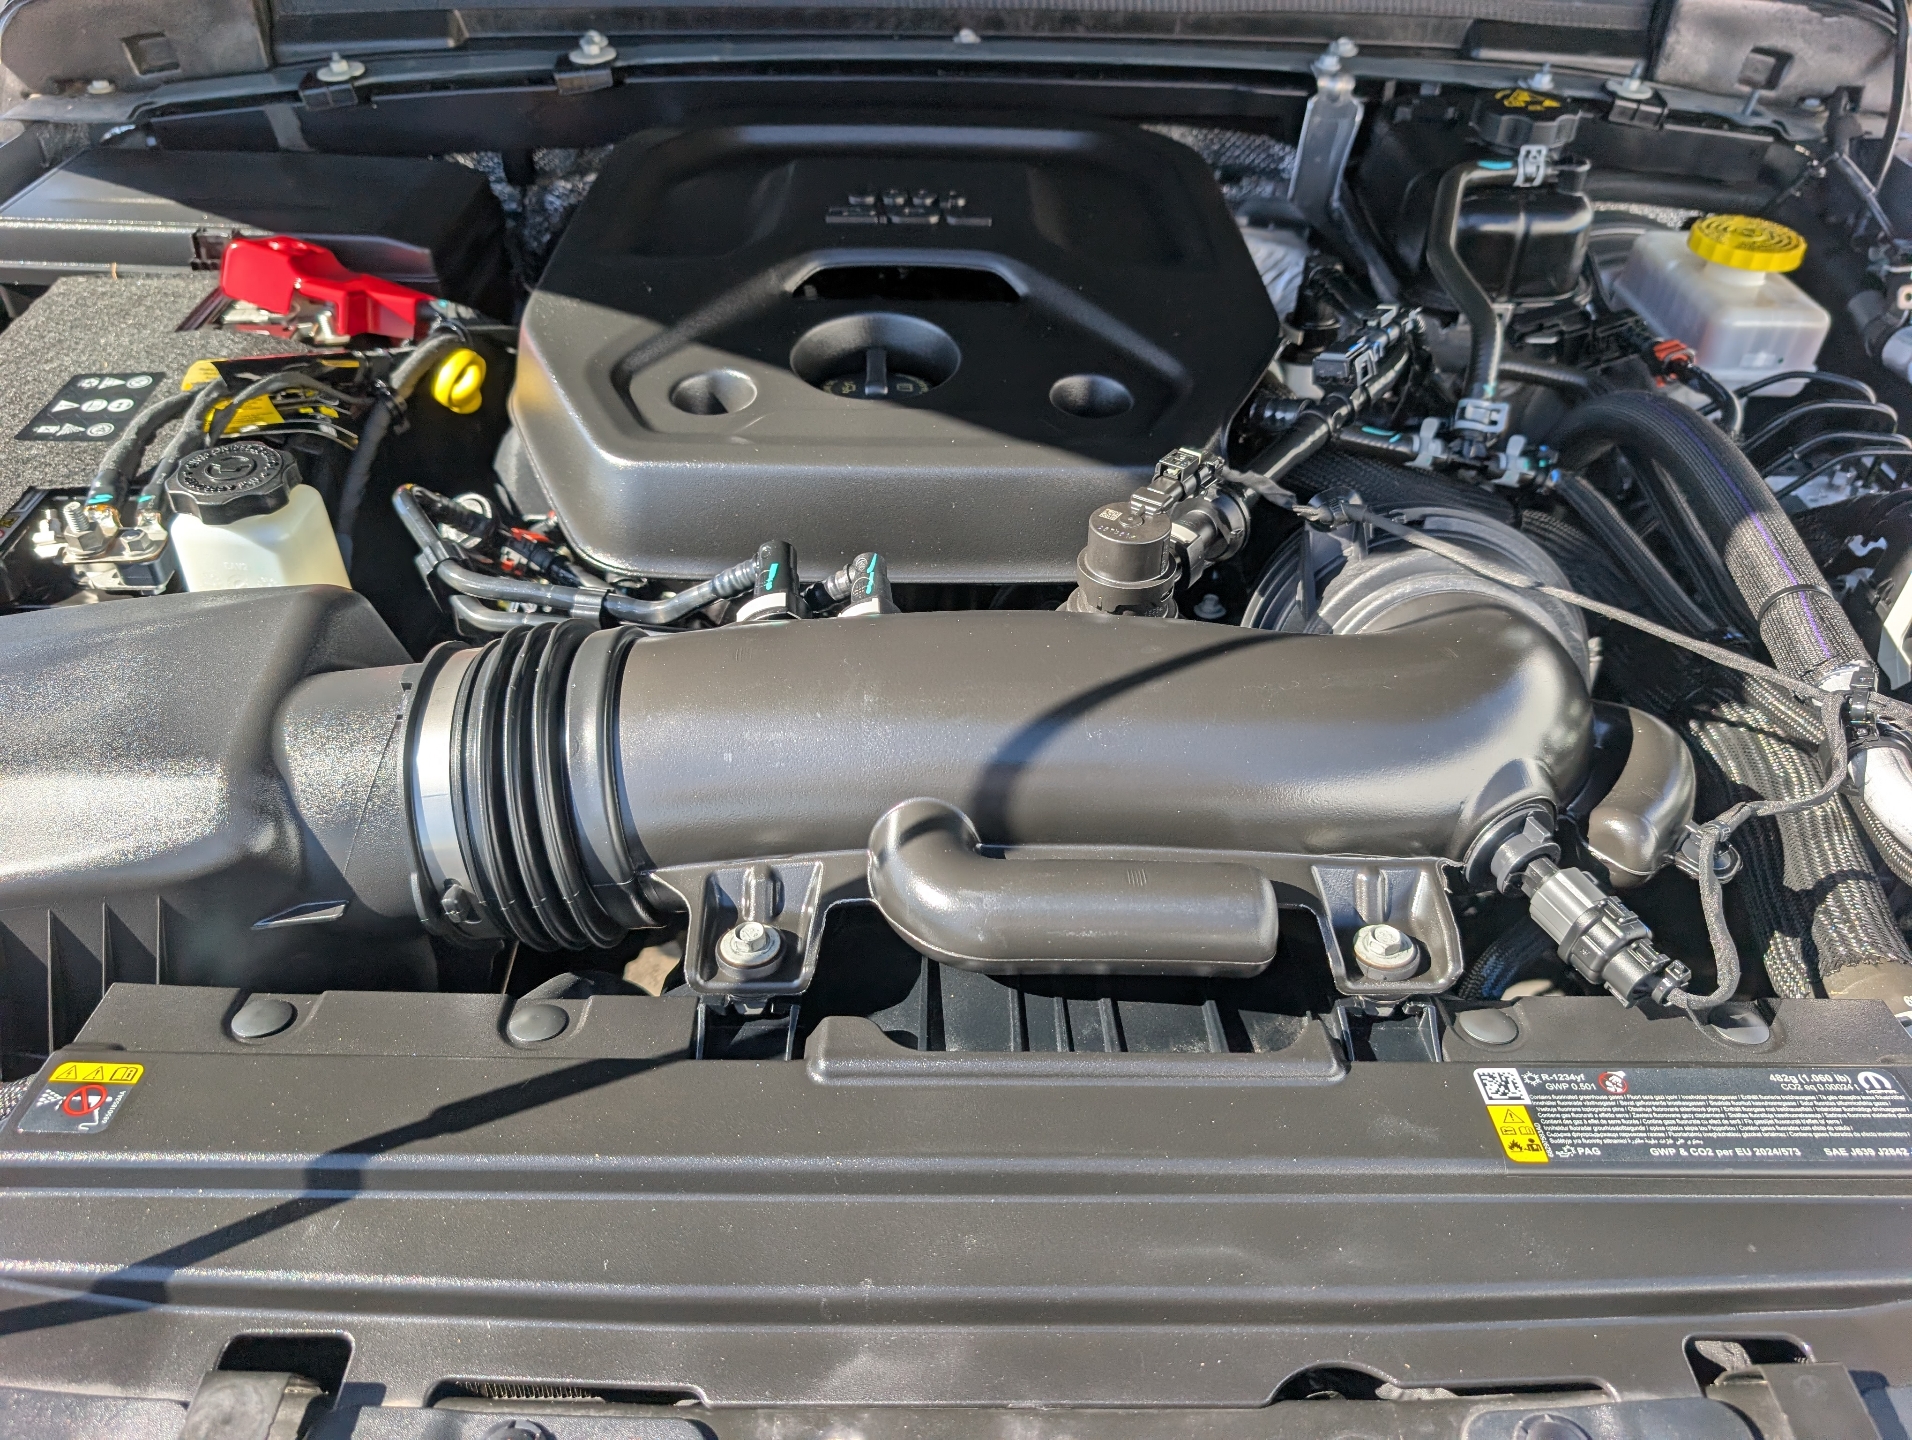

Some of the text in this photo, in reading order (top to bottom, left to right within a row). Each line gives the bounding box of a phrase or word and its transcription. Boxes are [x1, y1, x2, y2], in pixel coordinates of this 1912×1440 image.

[1541, 1073, 1586, 1082] R-1234yf
[1769, 1073, 1798, 1084] 482g
[1831, 1072, 1852, 1084] lb)
[1545, 1083, 1597, 1091] GWP 0.501
[1781, 1083, 1803, 1091] CO2
[1804, 1084, 1818, 1092] eq
[1577, 1147, 1602, 1156] PAG
[1650, 1147, 1802, 1158] GWP & CO2 per EU 2024/573
[1823, 1147, 1849, 1156] SAE
[1850, 1147, 1876, 1156] J639
